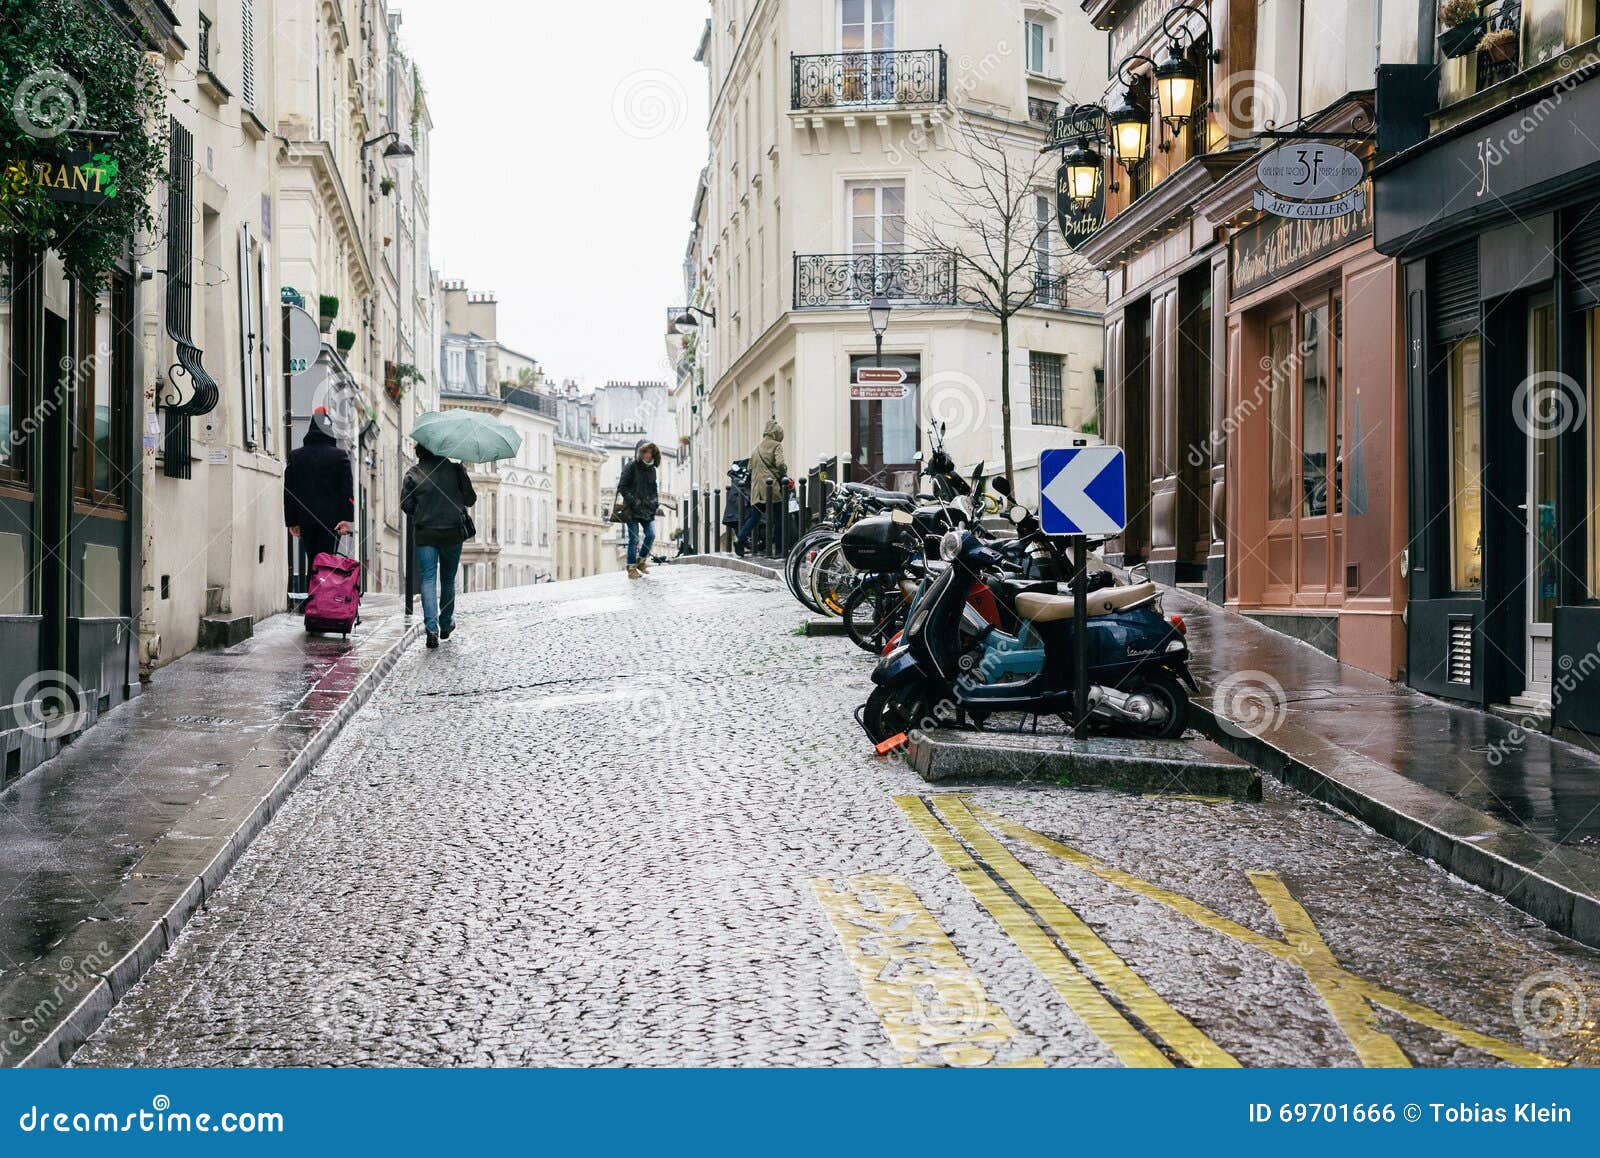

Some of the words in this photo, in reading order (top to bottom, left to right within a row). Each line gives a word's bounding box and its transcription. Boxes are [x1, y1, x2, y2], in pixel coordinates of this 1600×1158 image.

[1293, 150, 1323, 185] 3F
[1268, 201, 1294, 215] ART
[1296, 200, 1350, 216] GALLERY
[1064, 213, 1098, 237] Butte
